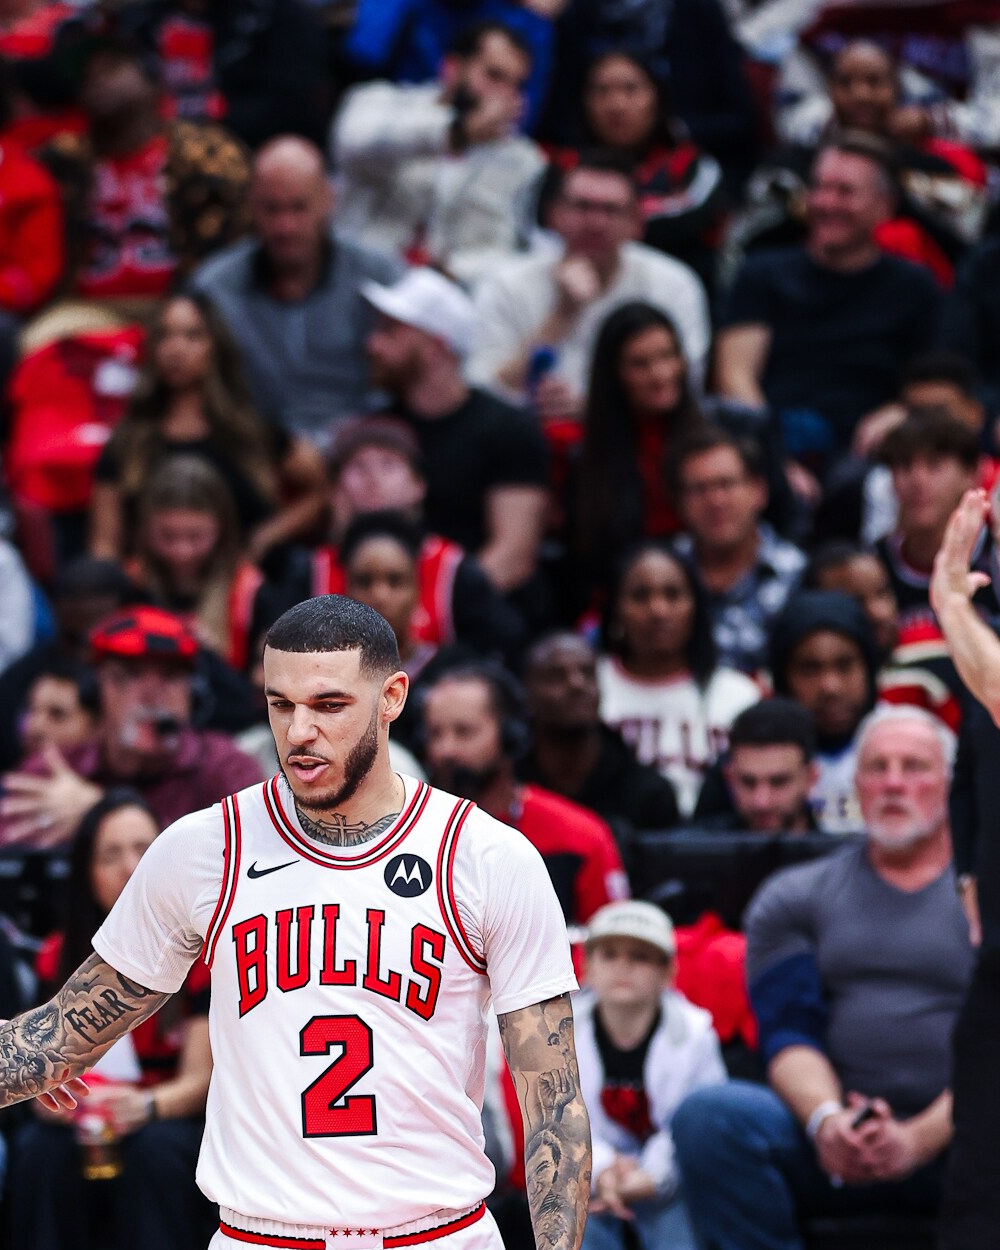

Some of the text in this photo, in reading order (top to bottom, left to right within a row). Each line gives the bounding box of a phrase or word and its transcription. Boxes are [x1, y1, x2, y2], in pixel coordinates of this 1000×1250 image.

[64, 989, 142, 1046] FEAR
[232, 903, 446, 1022] BULLS
[299, 1014, 378, 1138] 2
